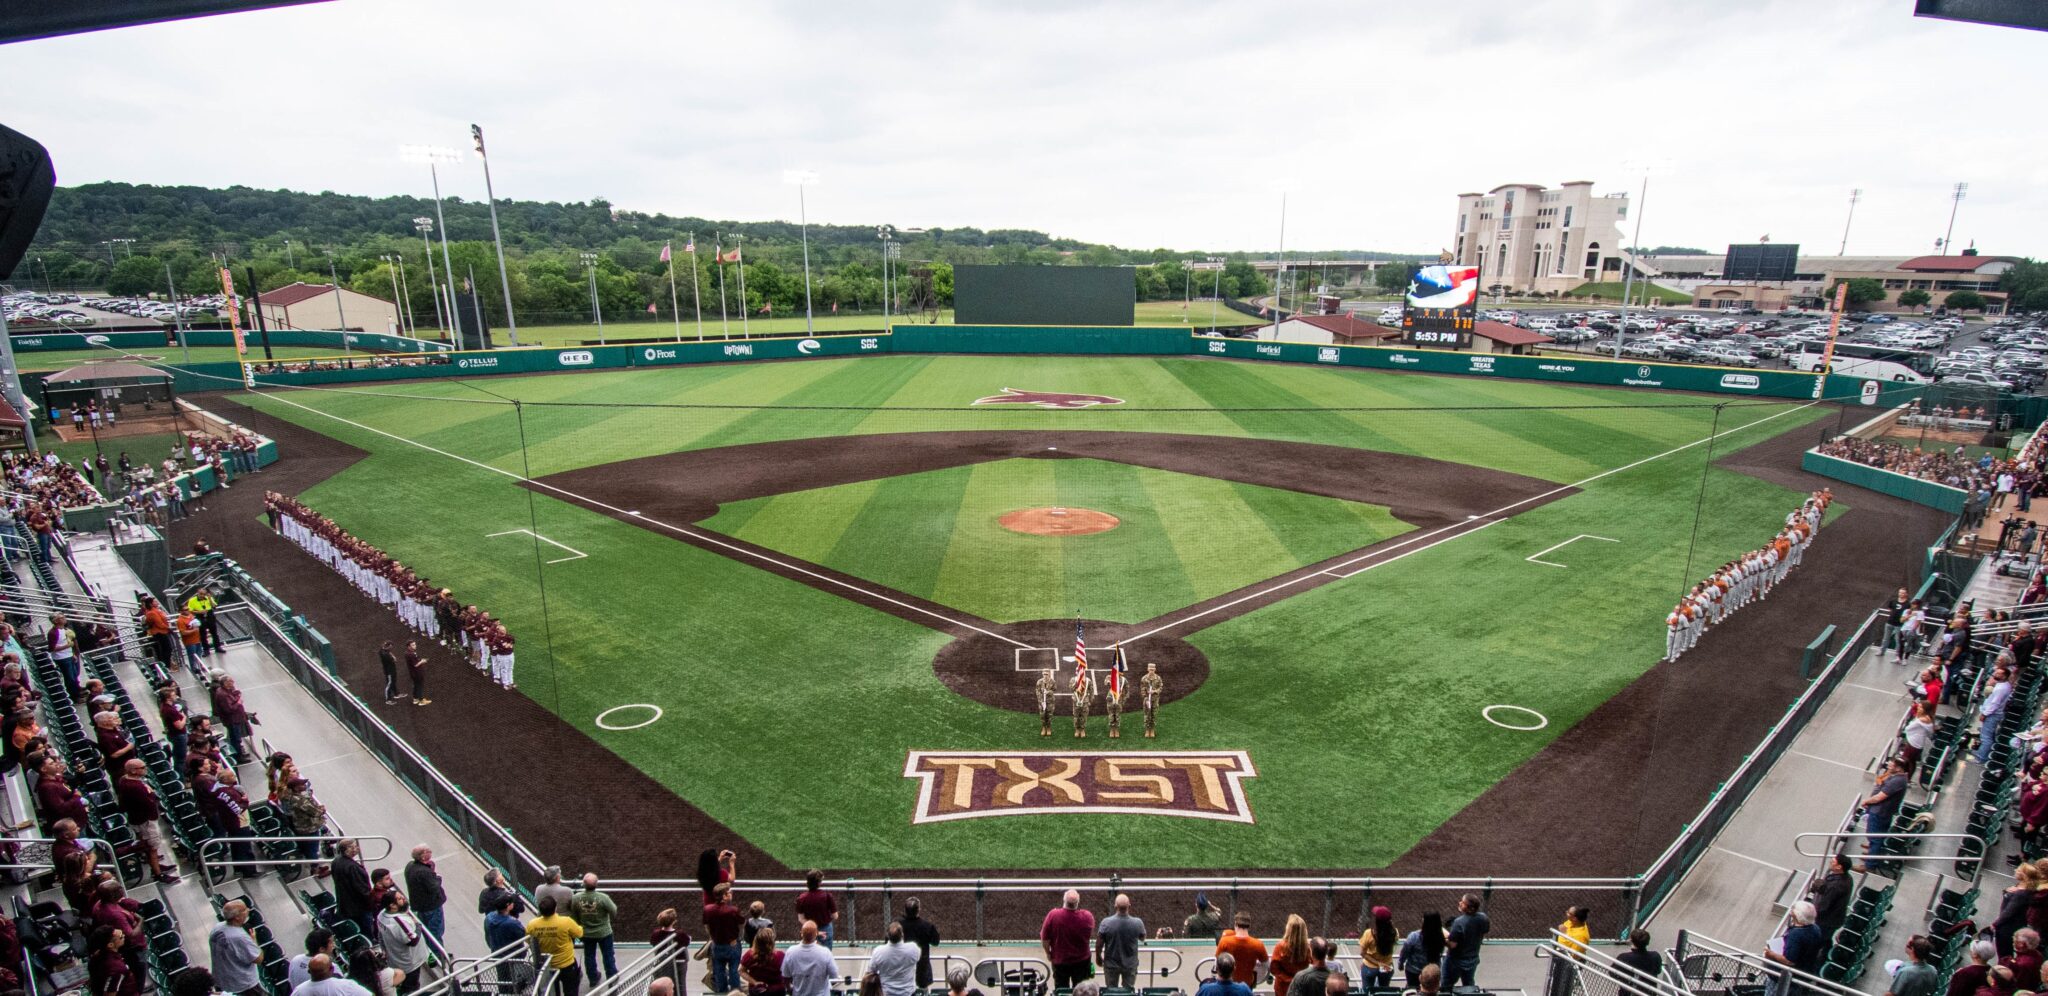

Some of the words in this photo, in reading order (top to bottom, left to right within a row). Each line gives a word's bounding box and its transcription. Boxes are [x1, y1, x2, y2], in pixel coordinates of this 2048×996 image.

[1415, 331, 1437, 341] 5:53
[1440, 332, 1458, 343] PM
[861, 338, 878, 349] SBC
[1209, 341, 1226, 353] SBC
[1256, 344, 1280, 354] Fairfield
[657, 350, 676, 359] Frost
[1640, 368, 1648, 376] H
[925, 757, 1237, 811] TXST
